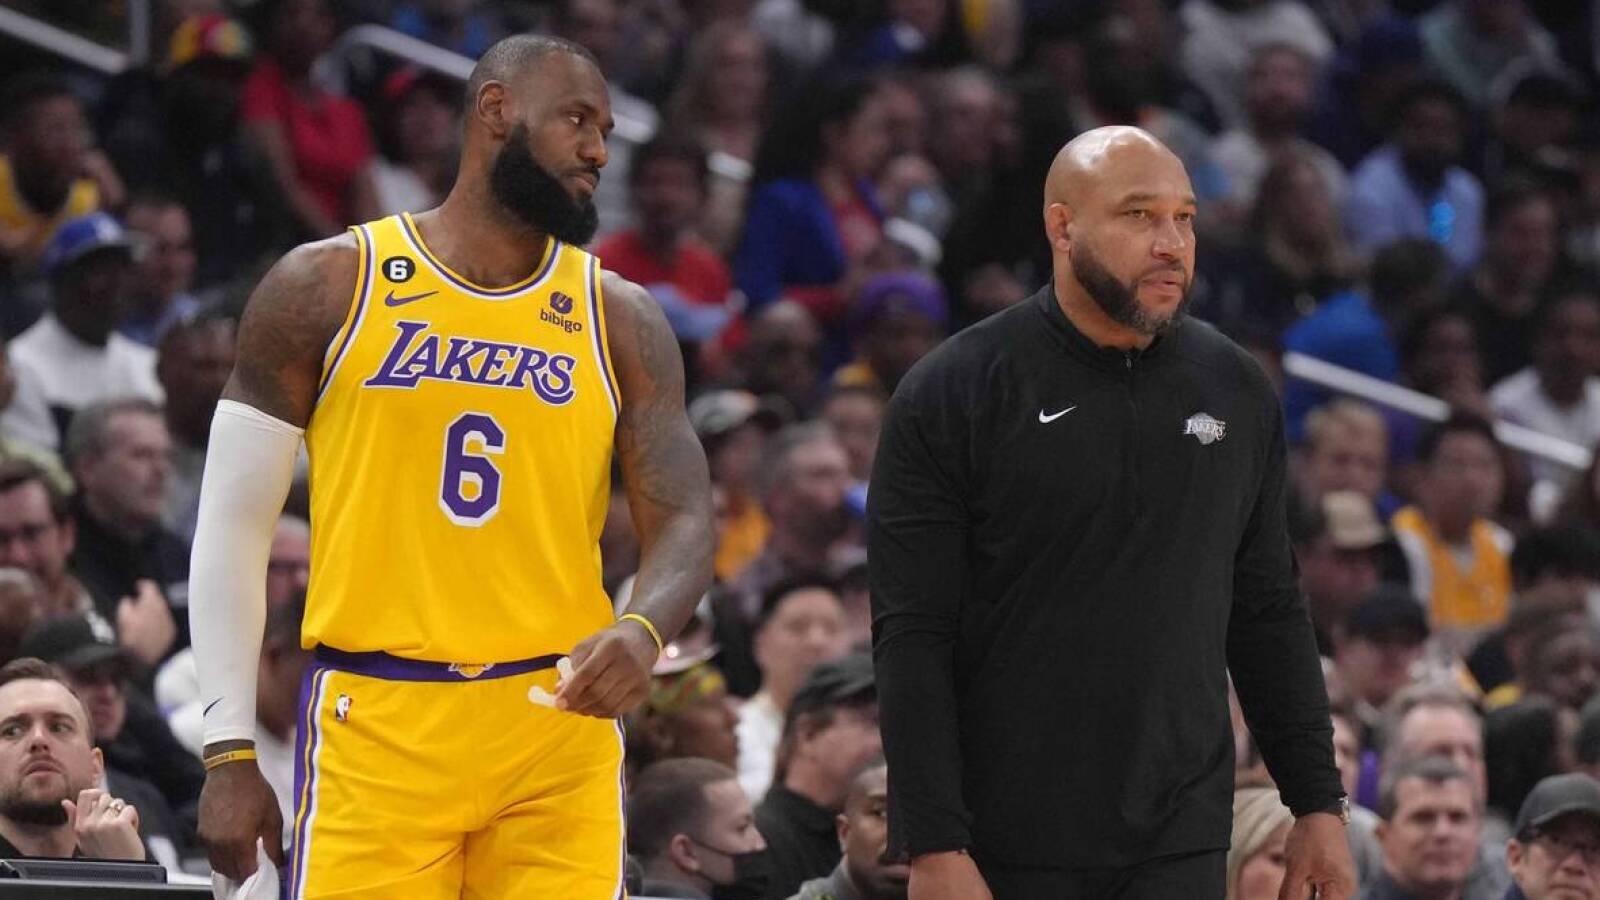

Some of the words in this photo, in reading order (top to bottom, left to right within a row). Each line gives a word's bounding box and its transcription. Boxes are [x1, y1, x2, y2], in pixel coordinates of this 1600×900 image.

[389, 259, 408, 281] 6
[540, 308, 582, 333] bibigo
[364, 320, 577, 405] LAKERS
[1183, 419, 1226, 441] LAKERS
[439, 411, 505, 527] 6
